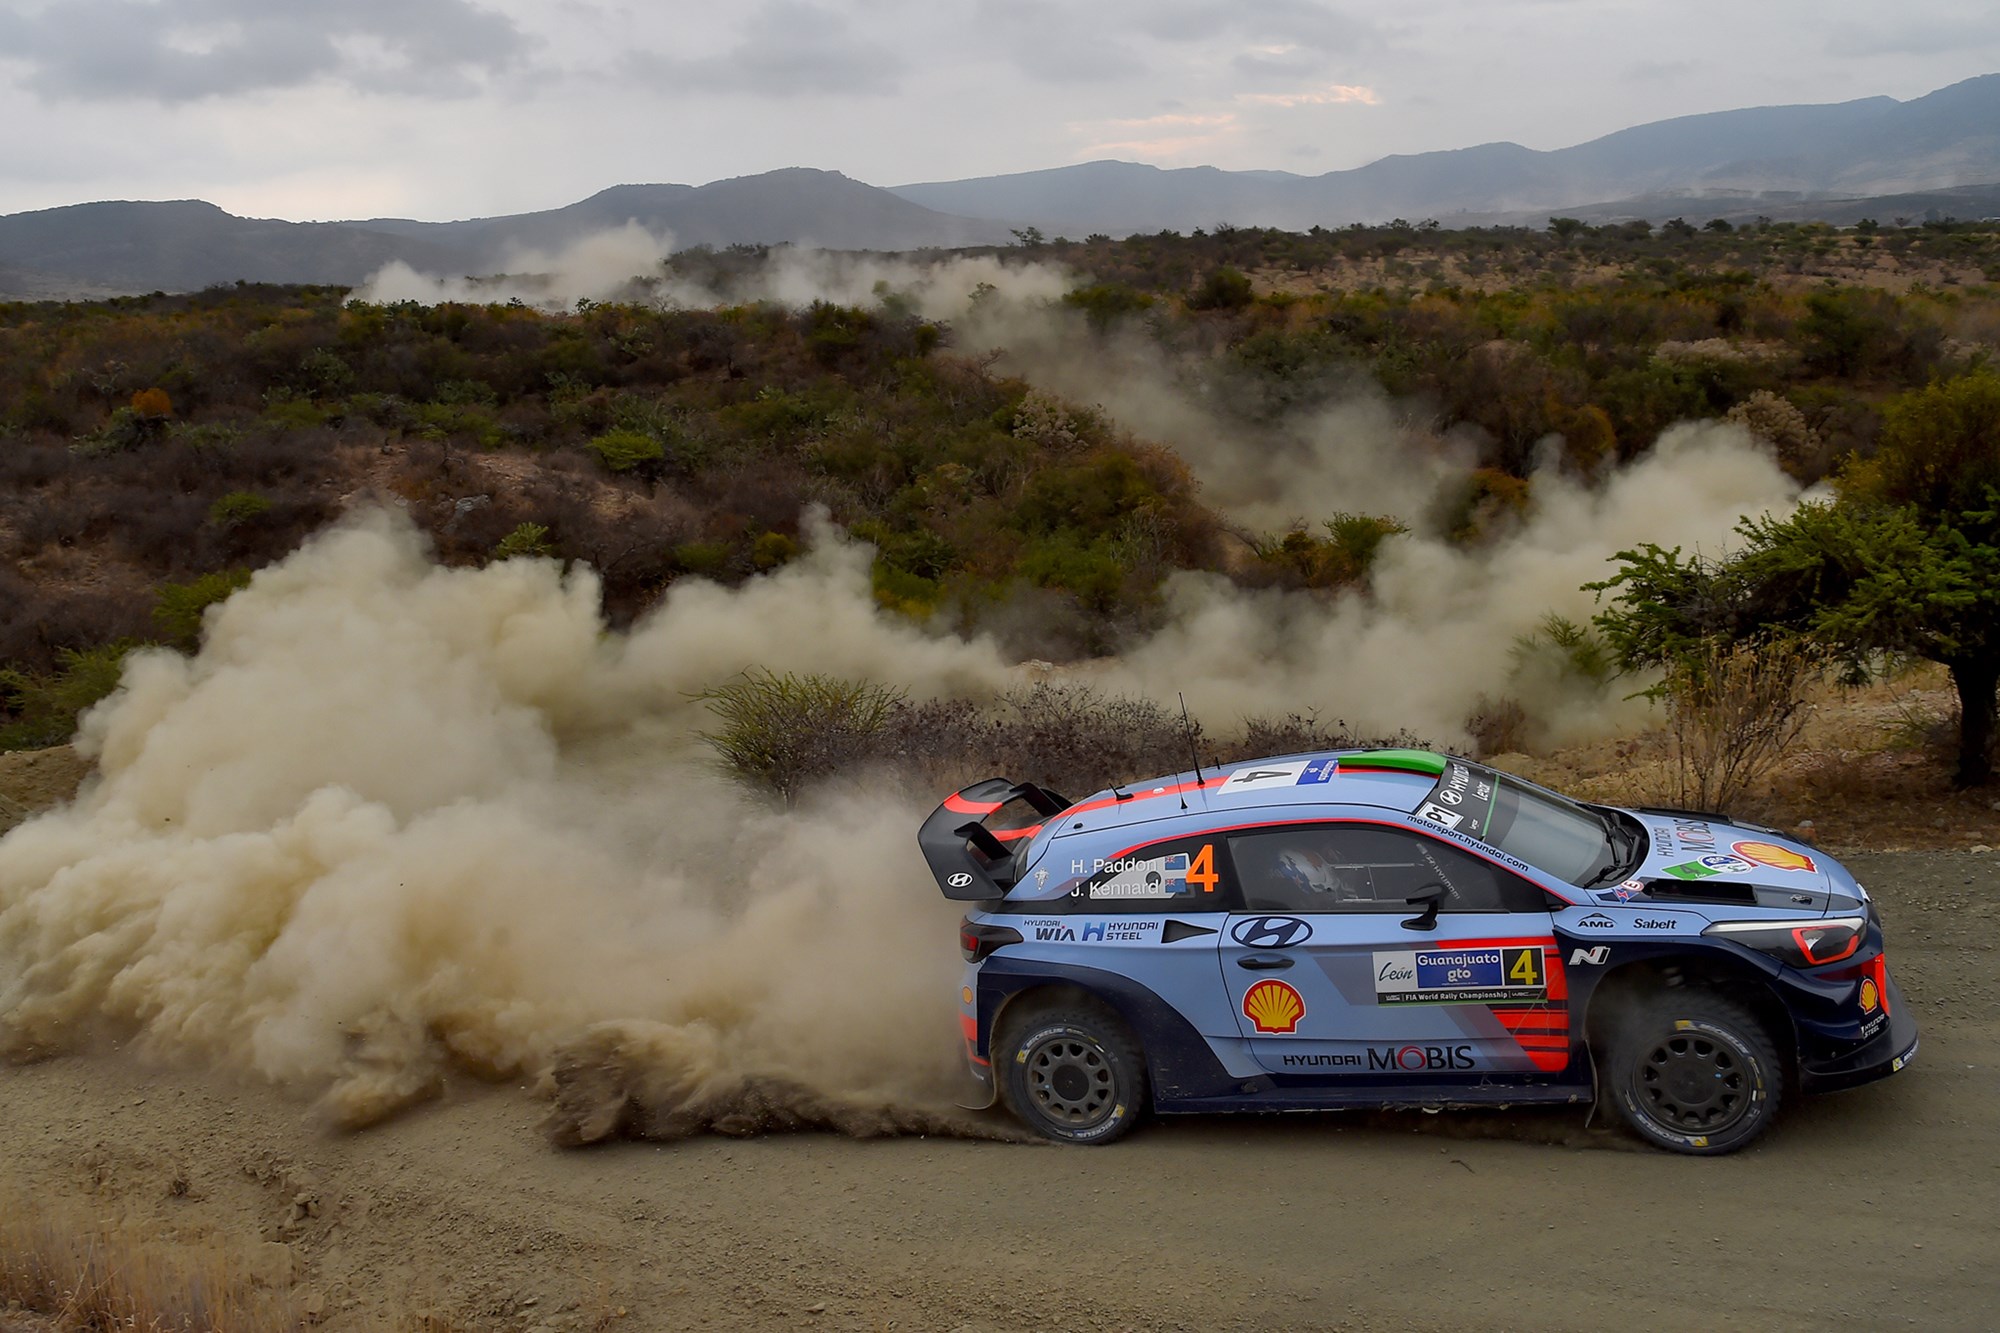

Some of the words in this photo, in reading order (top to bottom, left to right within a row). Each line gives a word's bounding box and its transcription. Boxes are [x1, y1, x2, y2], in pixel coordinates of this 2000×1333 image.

[1426, 806, 1455, 825] P1
[1406, 815, 1529, 872] motorsport.hyundai.com
[1071, 859, 1087, 874] H.
[1093, 857, 1157, 873] Paddon
[1185, 844, 1219, 893] 4
[1070, 883, 1084, 897] J.
[1090, 880, 1160, 896] Kennard
[1107, 922, 1159, 931] HYUNDAI
[1633, 918, 1677, 929] Sabelt
[1106, 932, 1142, 940] STEEL
[1417, 954, 1500, 968] Guanajuato
[1510, 949, 1538, 985] 4
[1378, 962, 1414, 982] León
[1447, 968, 1472, 982] gto
[1418, 993, 1438, 1001] World
[1440, 993, 1458, 1001] Rally
[1459, 991, 1508, 1000] Championship
[1283, 1055, 1361, 1066] HYUNDAI
[1366, 1045, 1475, 1071] MOBIS
